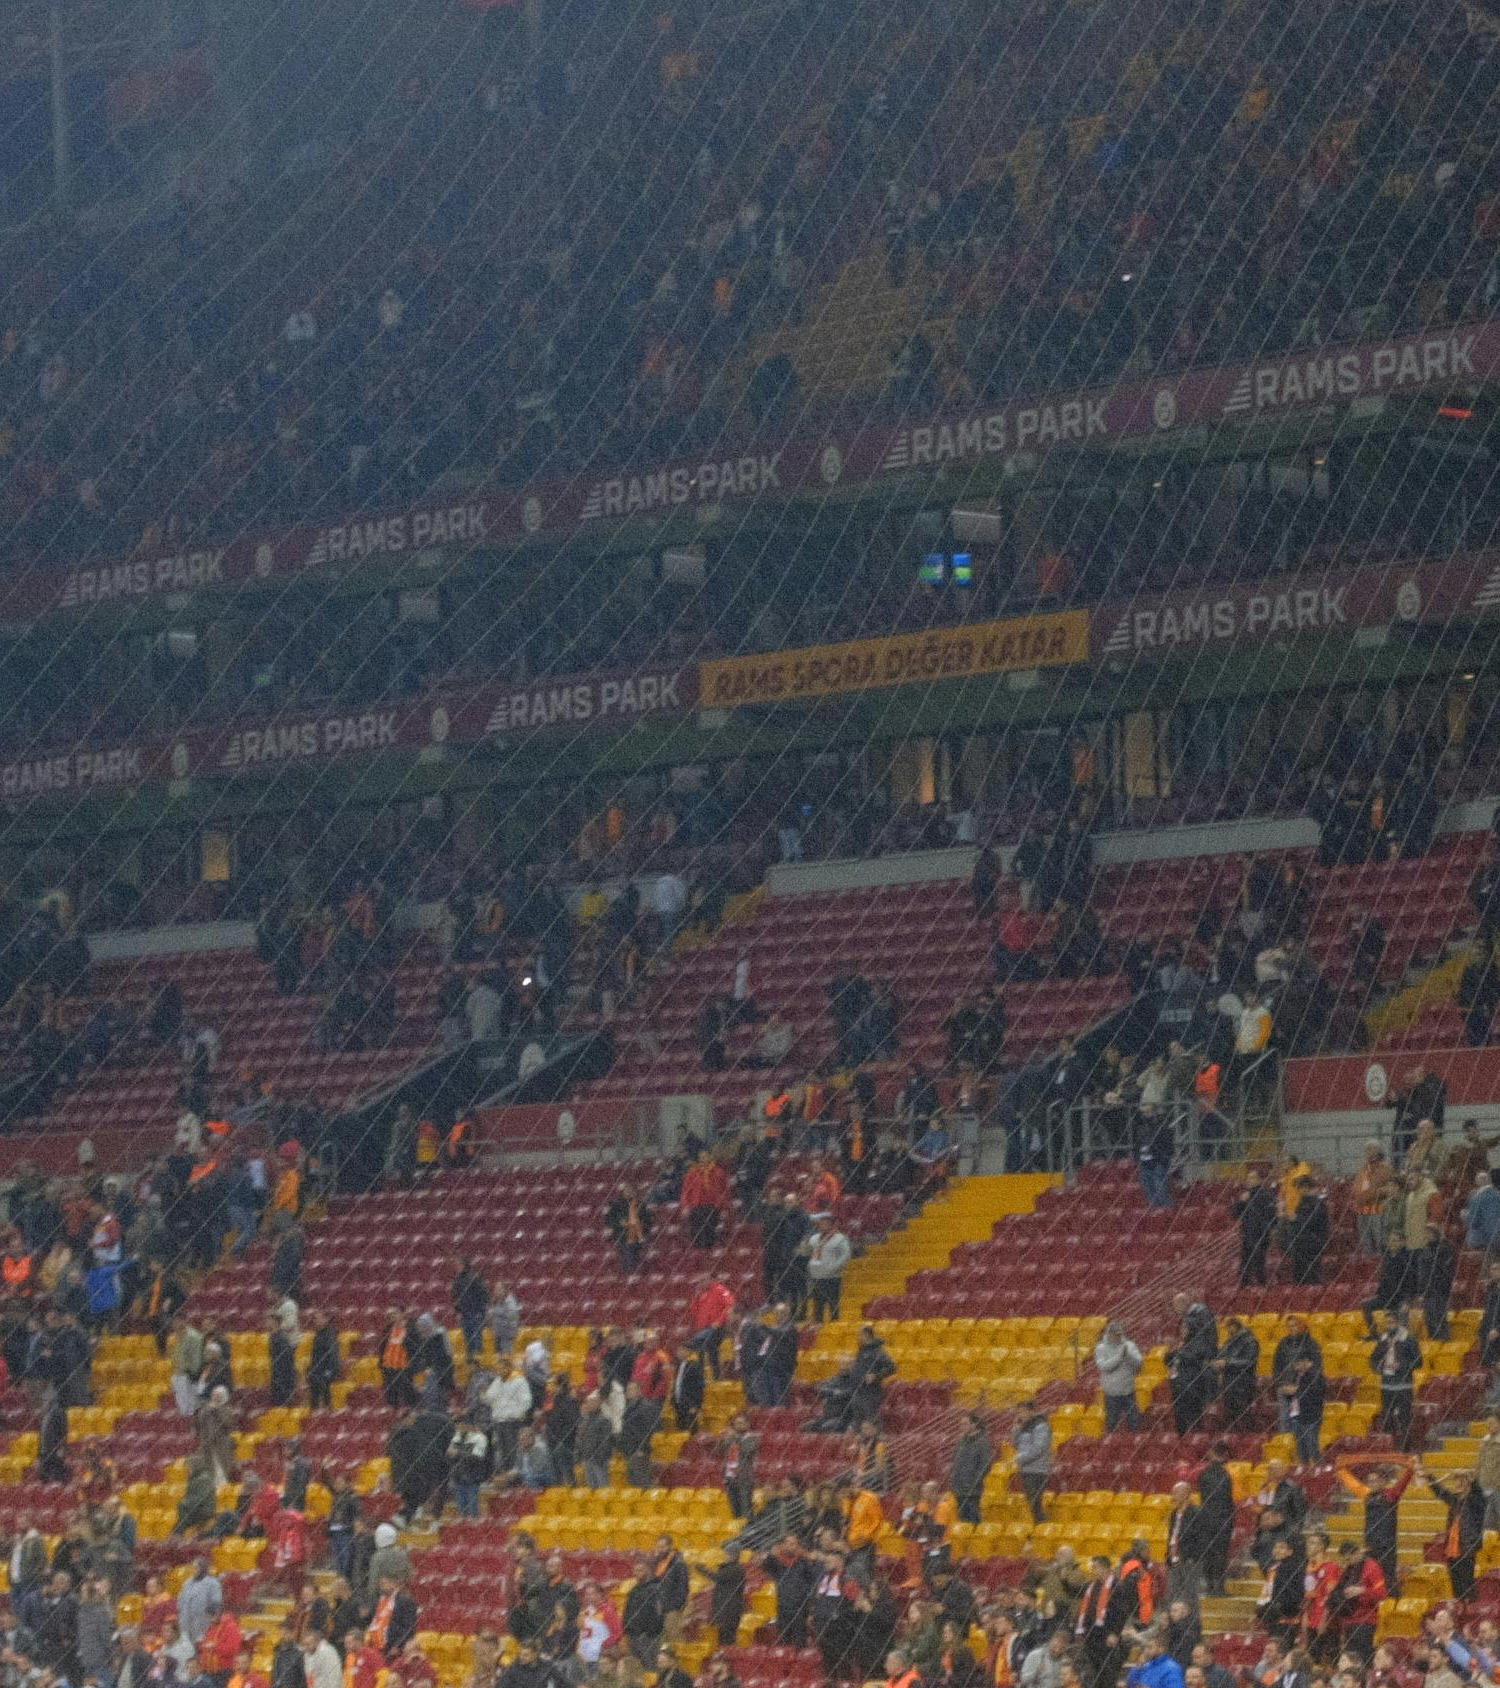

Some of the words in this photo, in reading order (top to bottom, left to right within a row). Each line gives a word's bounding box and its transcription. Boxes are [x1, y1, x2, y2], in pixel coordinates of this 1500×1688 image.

[1255, 355, 1362, 408] RAMS
[1370, 336, 1477, 387] PARK
[909, 414, 1008, 464] RAMS
[1016, 398, 1108, 445] PARK
[603, 468, 694, 515] RAMS
[700, 452, 781, 498] PARK
[327, 516, 404, 560] RAMS
[414, 504, 487, 545] PARK
[80, 561, 151, 601] RAMS
[155, 550, 225, 589] PARK
[1135, 598, 1235, 647] RAMS
[1247, 585, 1347, 632] PARK
[714, 665, 785, 700] RAMS
[795, 656, 880, 693] SPORA
[981, 622, 1068, 665] KATAR
[510, 684, 594, 727] RAMS
[602, 672, 680, 714] PARK
[241, 721, 318, 762] RAMS
[326, 711, 399, 752] PARK
[0, 756, 71, 794] RAMS
[77, 747, 142, 783] PARK
